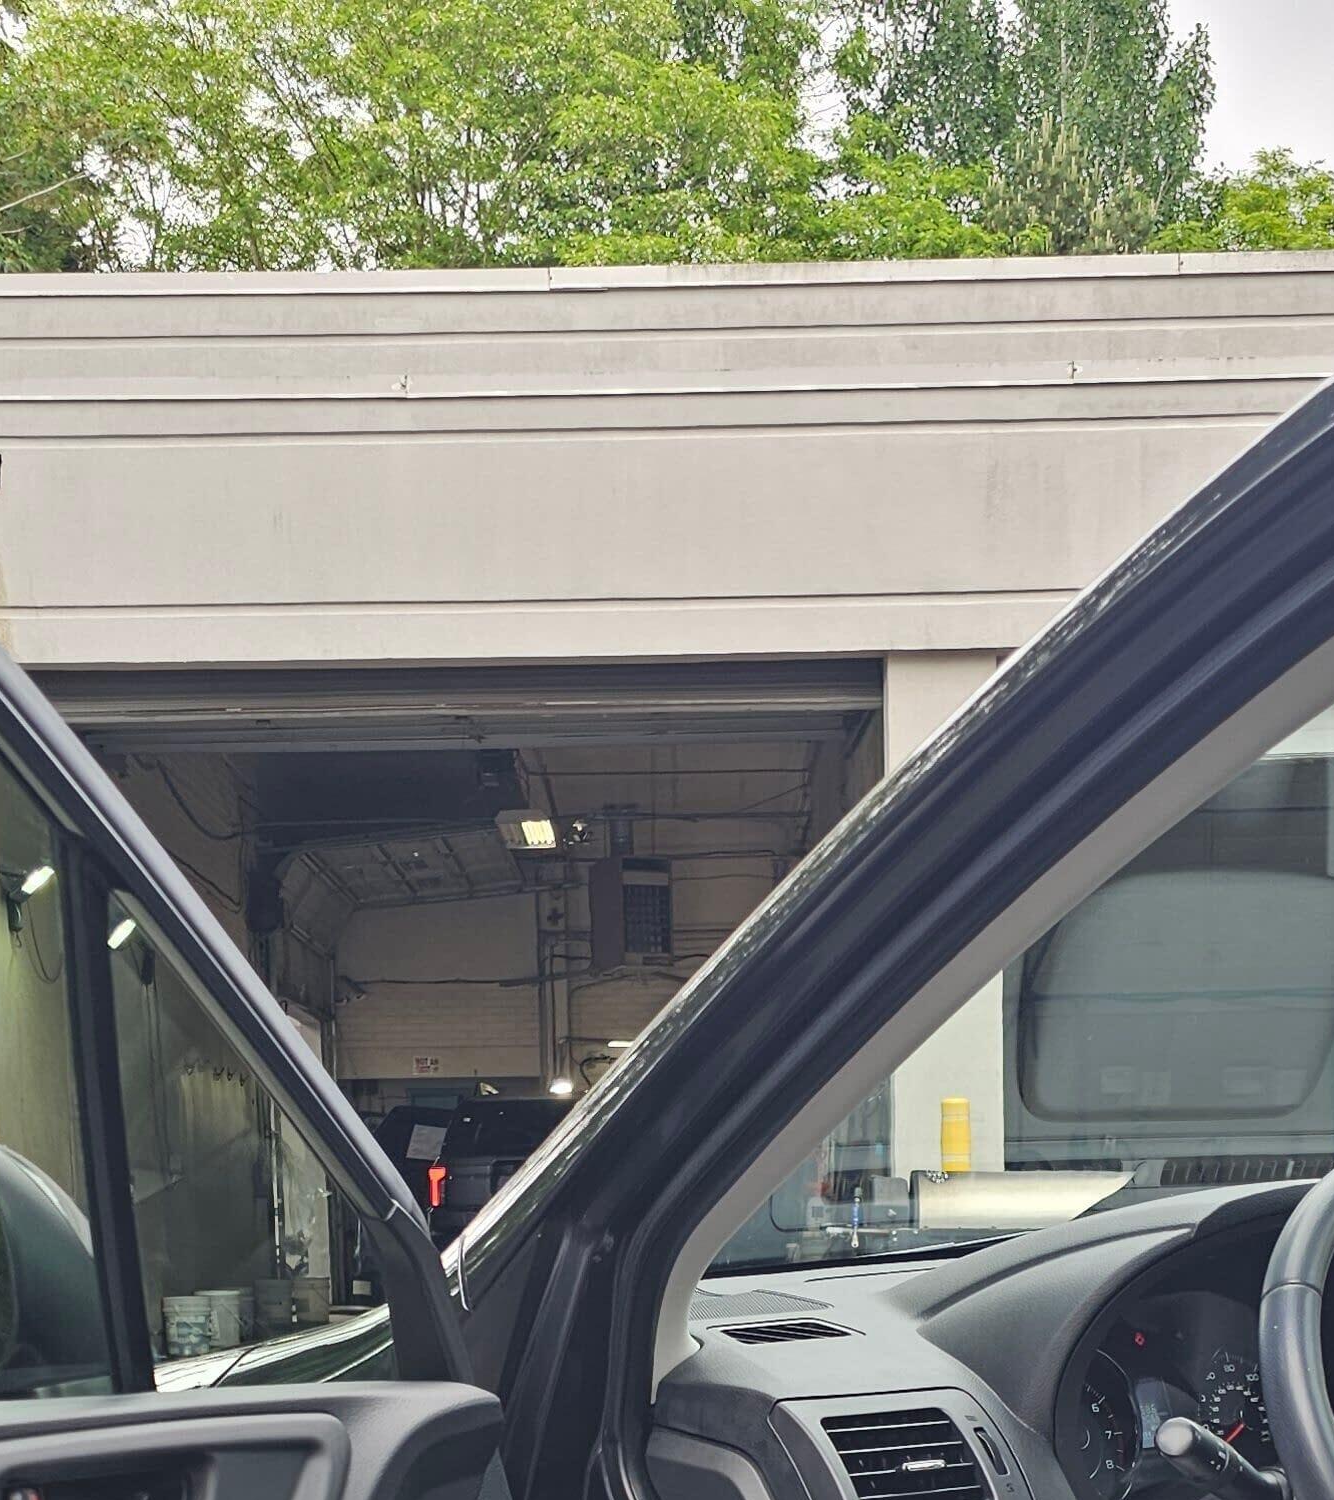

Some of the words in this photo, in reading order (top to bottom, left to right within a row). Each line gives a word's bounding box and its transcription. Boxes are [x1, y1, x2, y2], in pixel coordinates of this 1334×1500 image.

[1223, 1364, 1235, 1372] 80
[1091, 1403, 1100, 1413] 6
[1104, 1430, 1112, 1440] 7
[1105, 1459, 1114, 1469] 8
